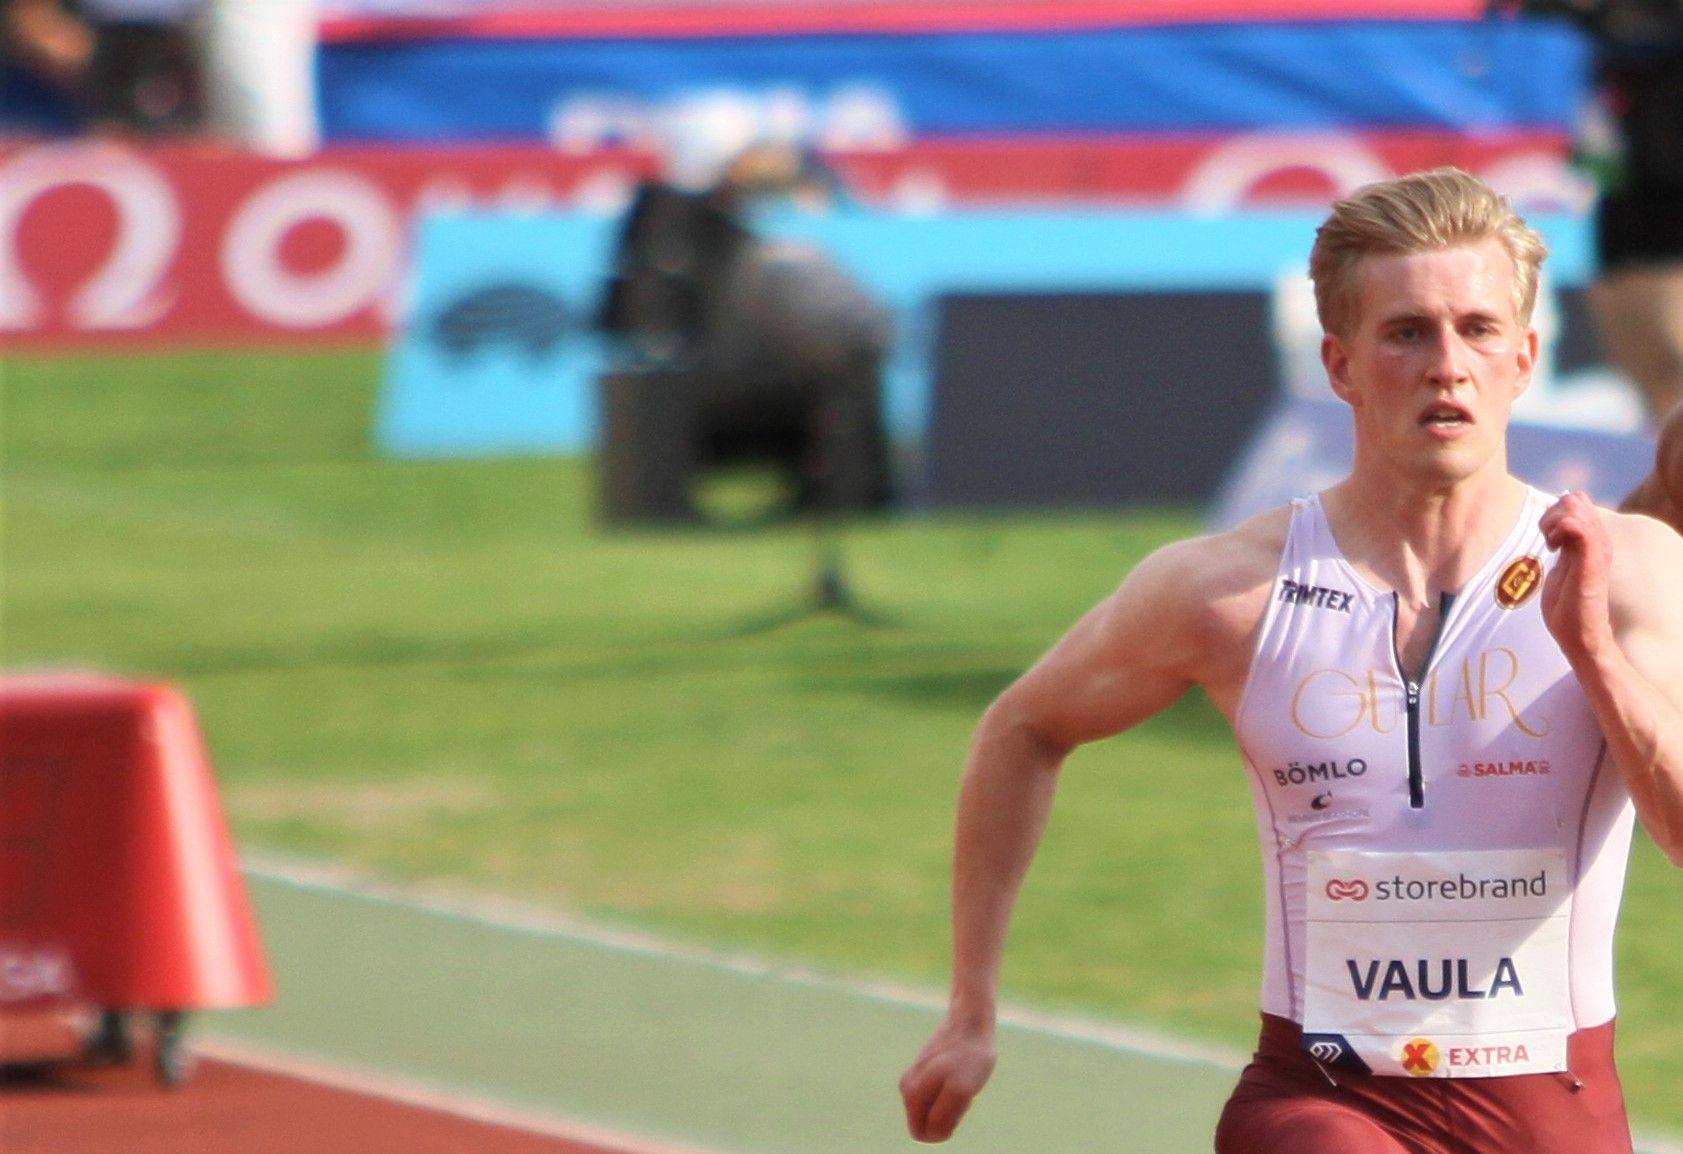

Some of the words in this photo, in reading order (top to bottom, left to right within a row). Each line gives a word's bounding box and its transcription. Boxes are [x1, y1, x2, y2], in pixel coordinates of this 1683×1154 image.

[1273, 759, 1367, 787] BÖMLO
[1376, 869, 1546, 900] storebrand
[1346, 957, 1524, 1000] VAULA
[1449, 1044, 1529, 1066] EXTRA
